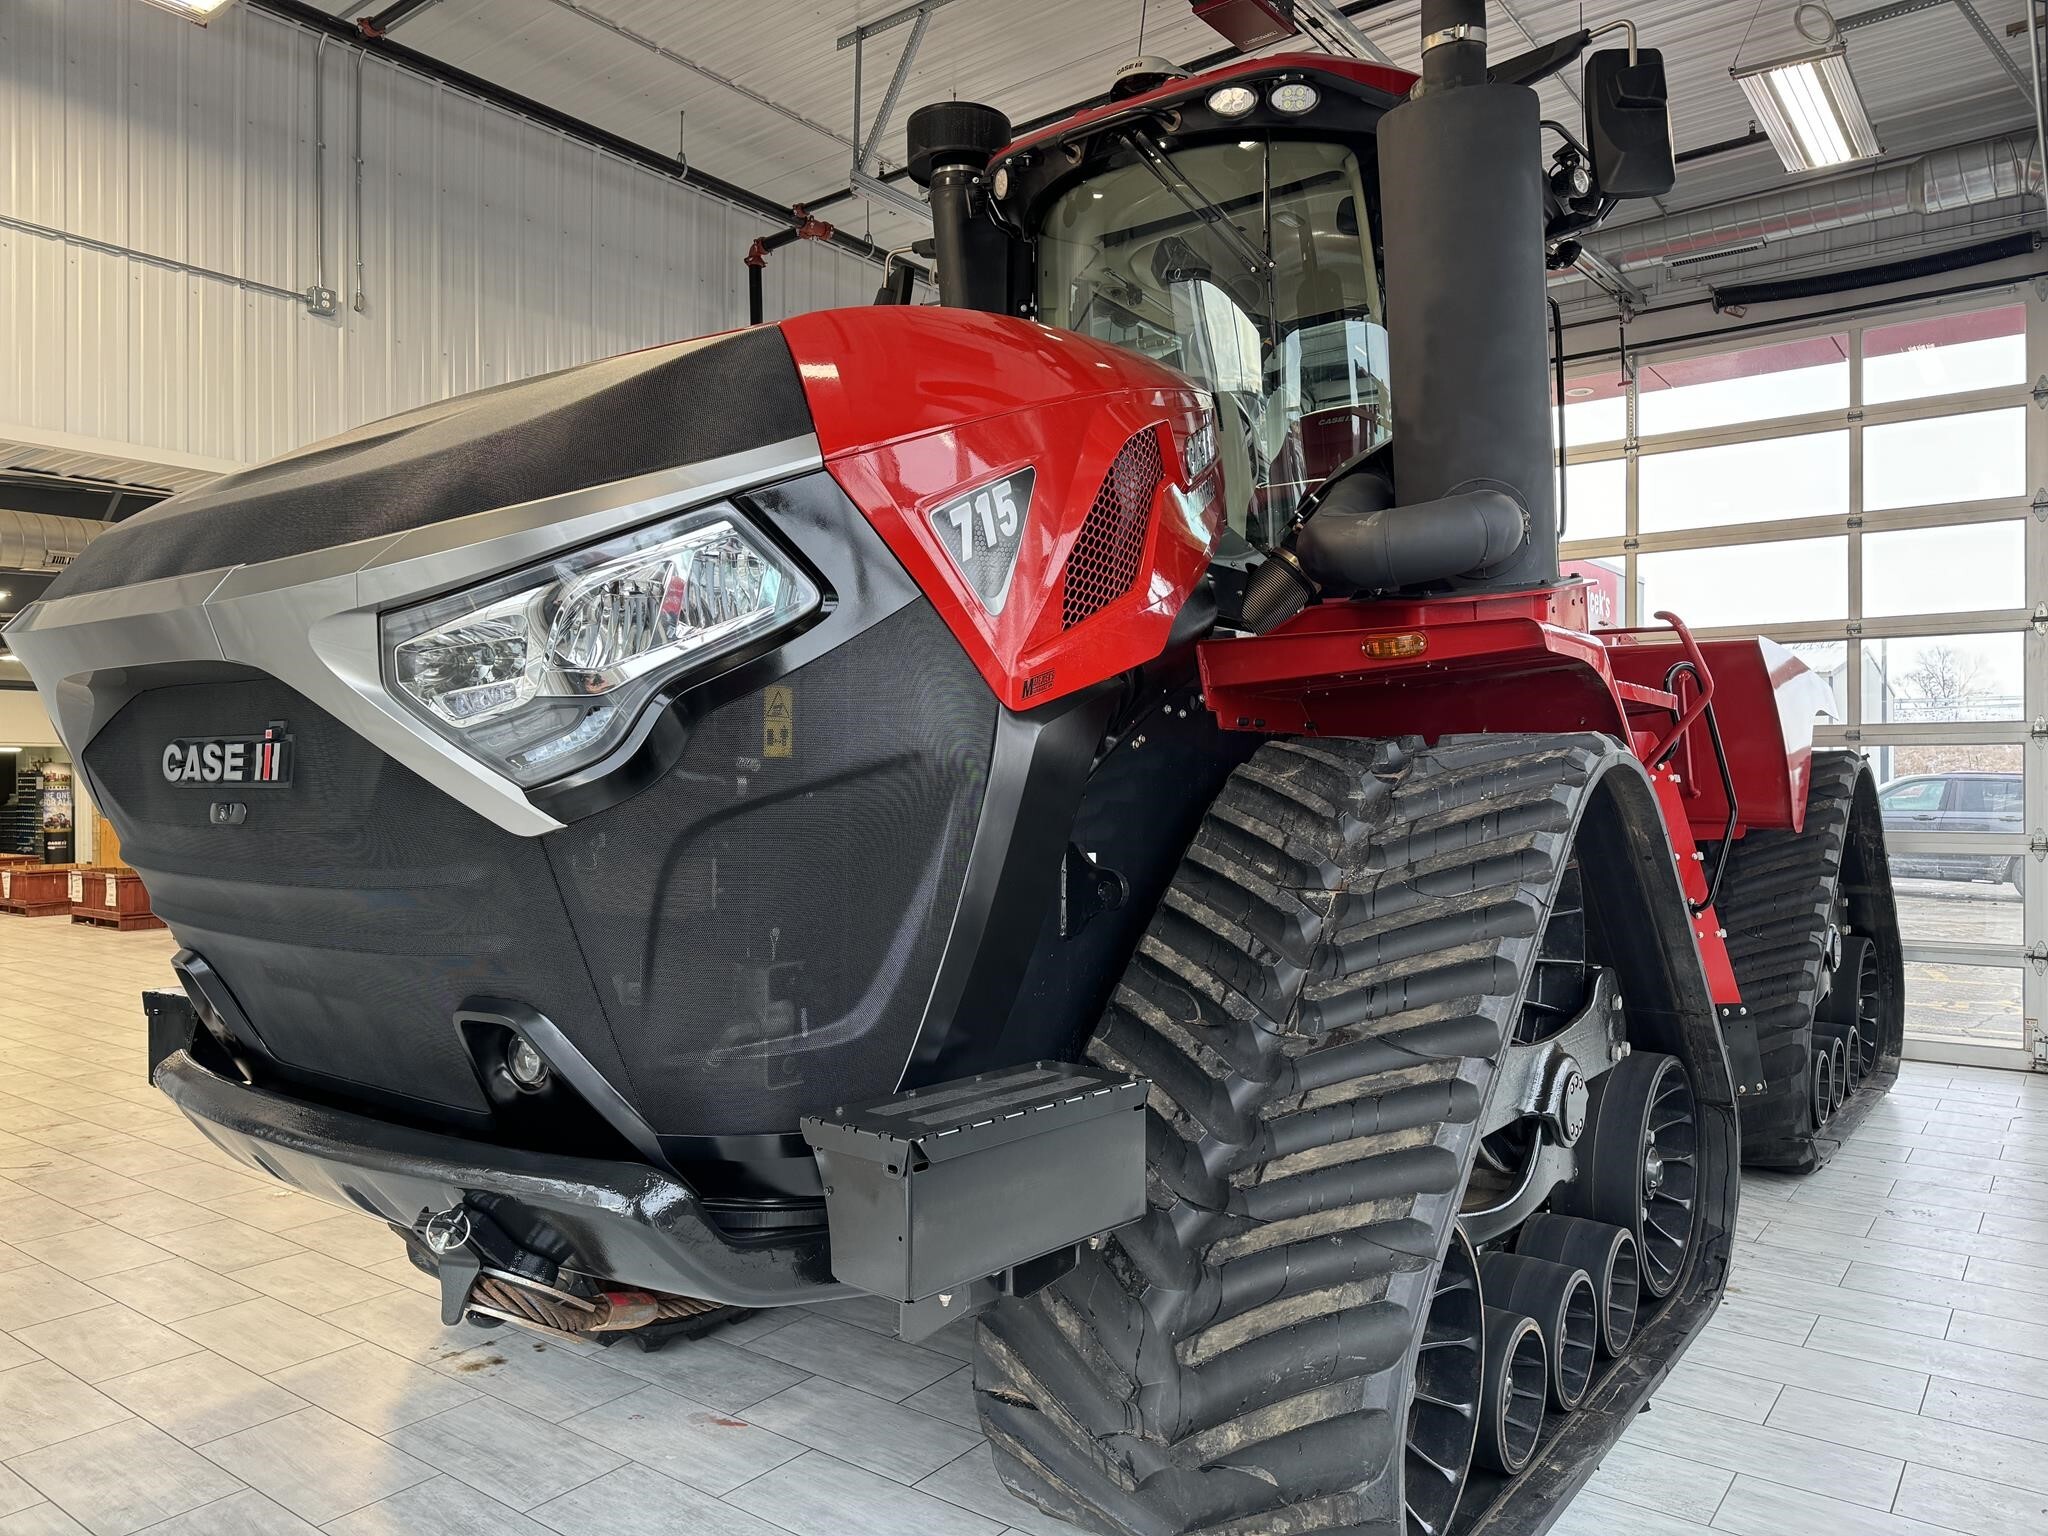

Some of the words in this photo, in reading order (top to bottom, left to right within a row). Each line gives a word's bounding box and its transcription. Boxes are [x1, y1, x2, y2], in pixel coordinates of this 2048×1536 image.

[1116, 63, 1134, 76] CASE
[949, 480, 1018, 563] 715
[162, 743, 245, 782] CASE
[254, 729, 281, 781] IH
